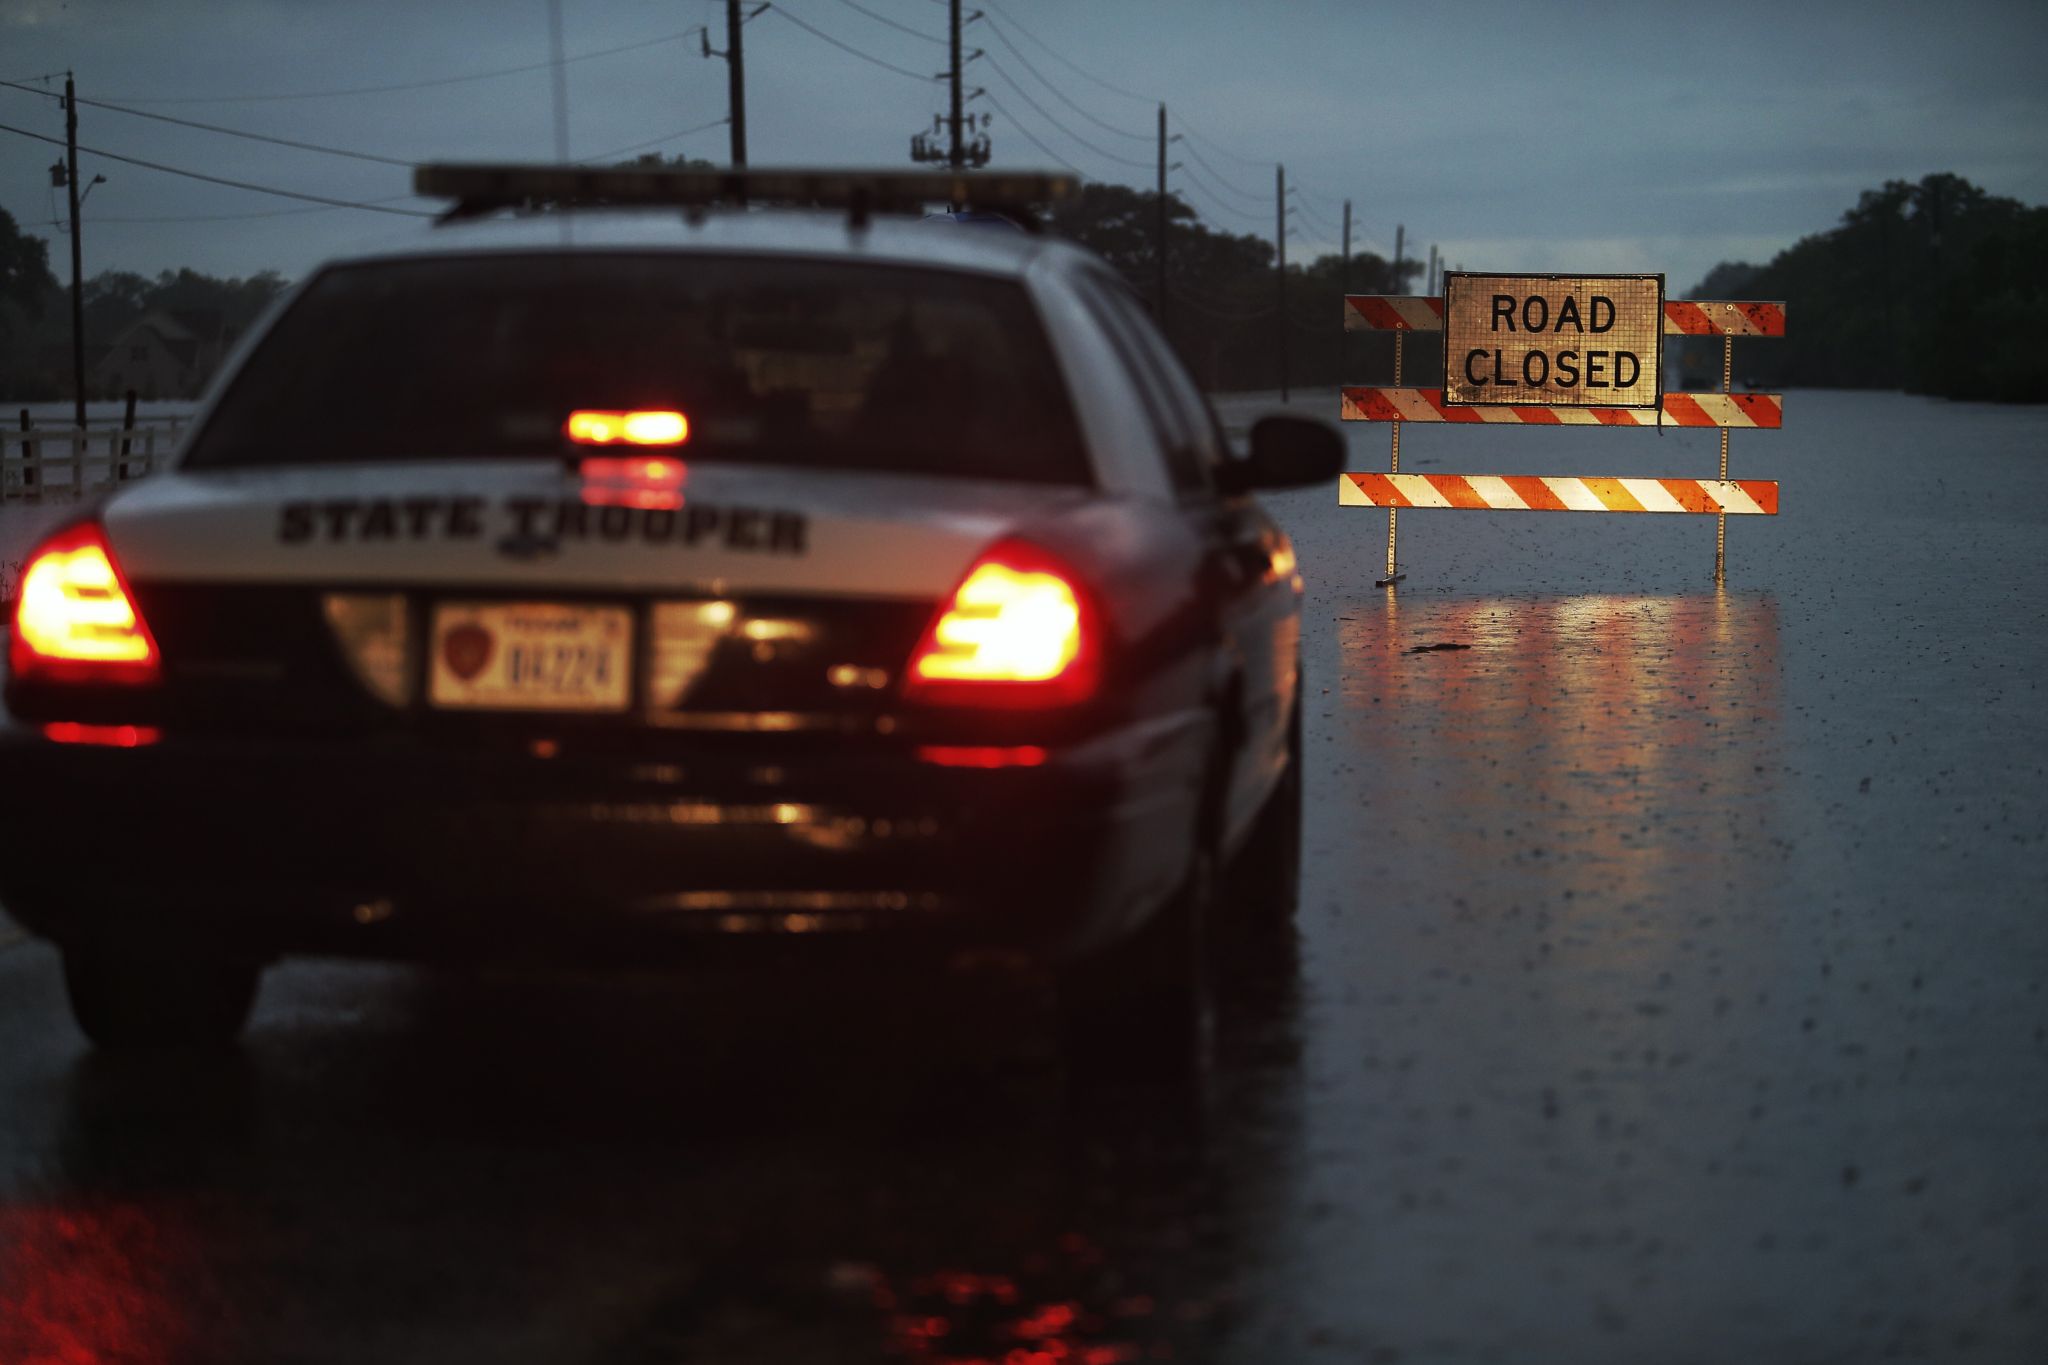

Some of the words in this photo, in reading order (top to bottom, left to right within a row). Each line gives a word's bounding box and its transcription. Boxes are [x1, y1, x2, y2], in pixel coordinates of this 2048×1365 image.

[1491, 295, 1616, 333] ROAD
[1465, 349, 1640, 388] CLOSED
[279, 499, 486, 544] STATE
[506, 499, 808, 554] TROOPER
